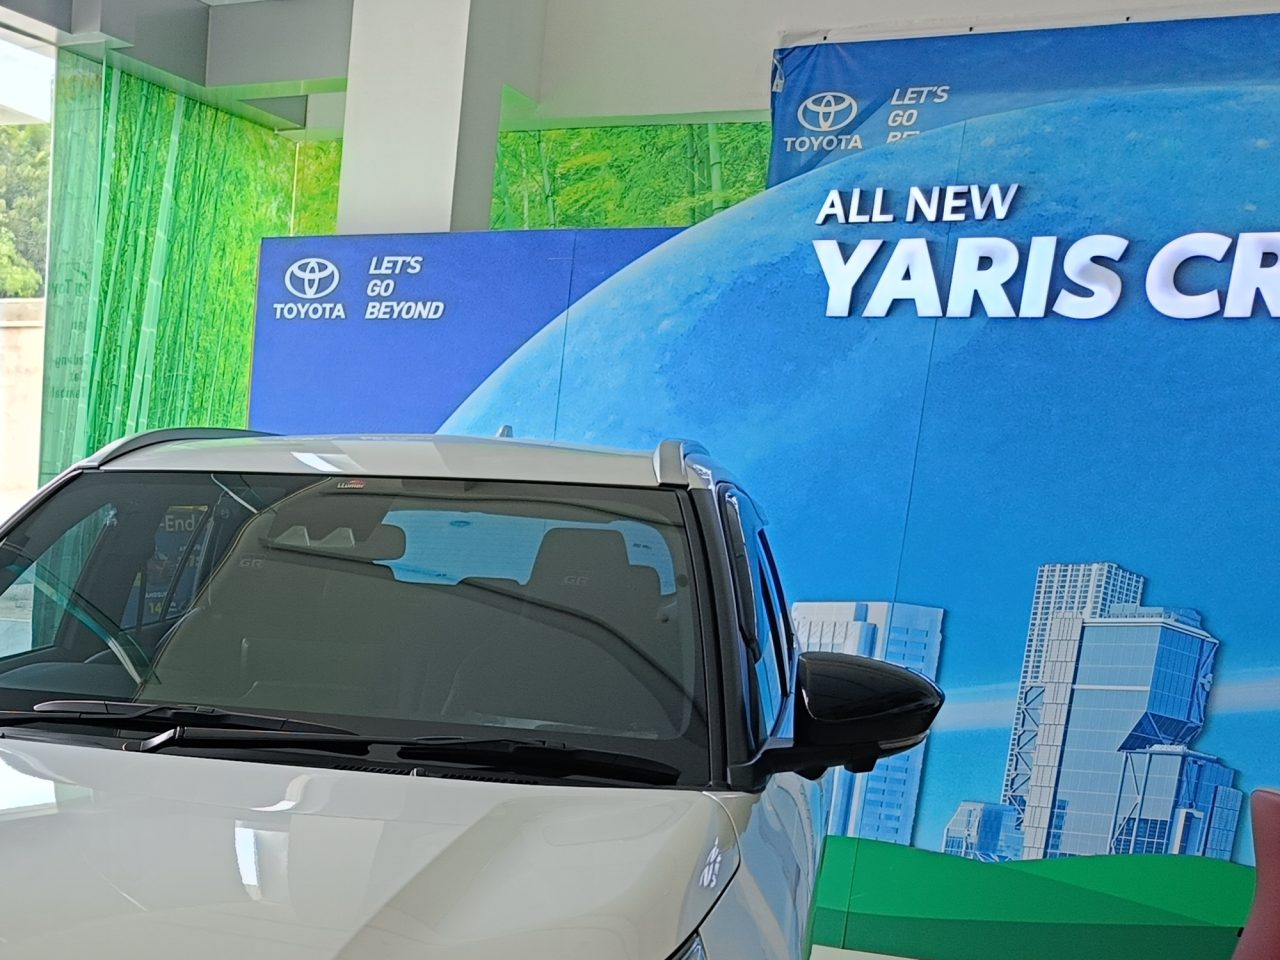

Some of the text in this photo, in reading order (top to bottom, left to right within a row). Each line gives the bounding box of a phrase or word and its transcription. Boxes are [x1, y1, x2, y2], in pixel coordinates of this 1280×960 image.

[890, 86, 951, 105] LET'S
[888, 109, 918, 127] GO
[783, 134, 863, 152] TOYOTA
[815, 183, 1019, 225] ALL NEW
[368, 256, 423, 274] LET'S
[812, 233, 1130, 319] YARIS
[366, 279, 395, 296] GO
[273, 303, 346, 319] TOYOTA
[365, 301, 445, 319] BEYOND
